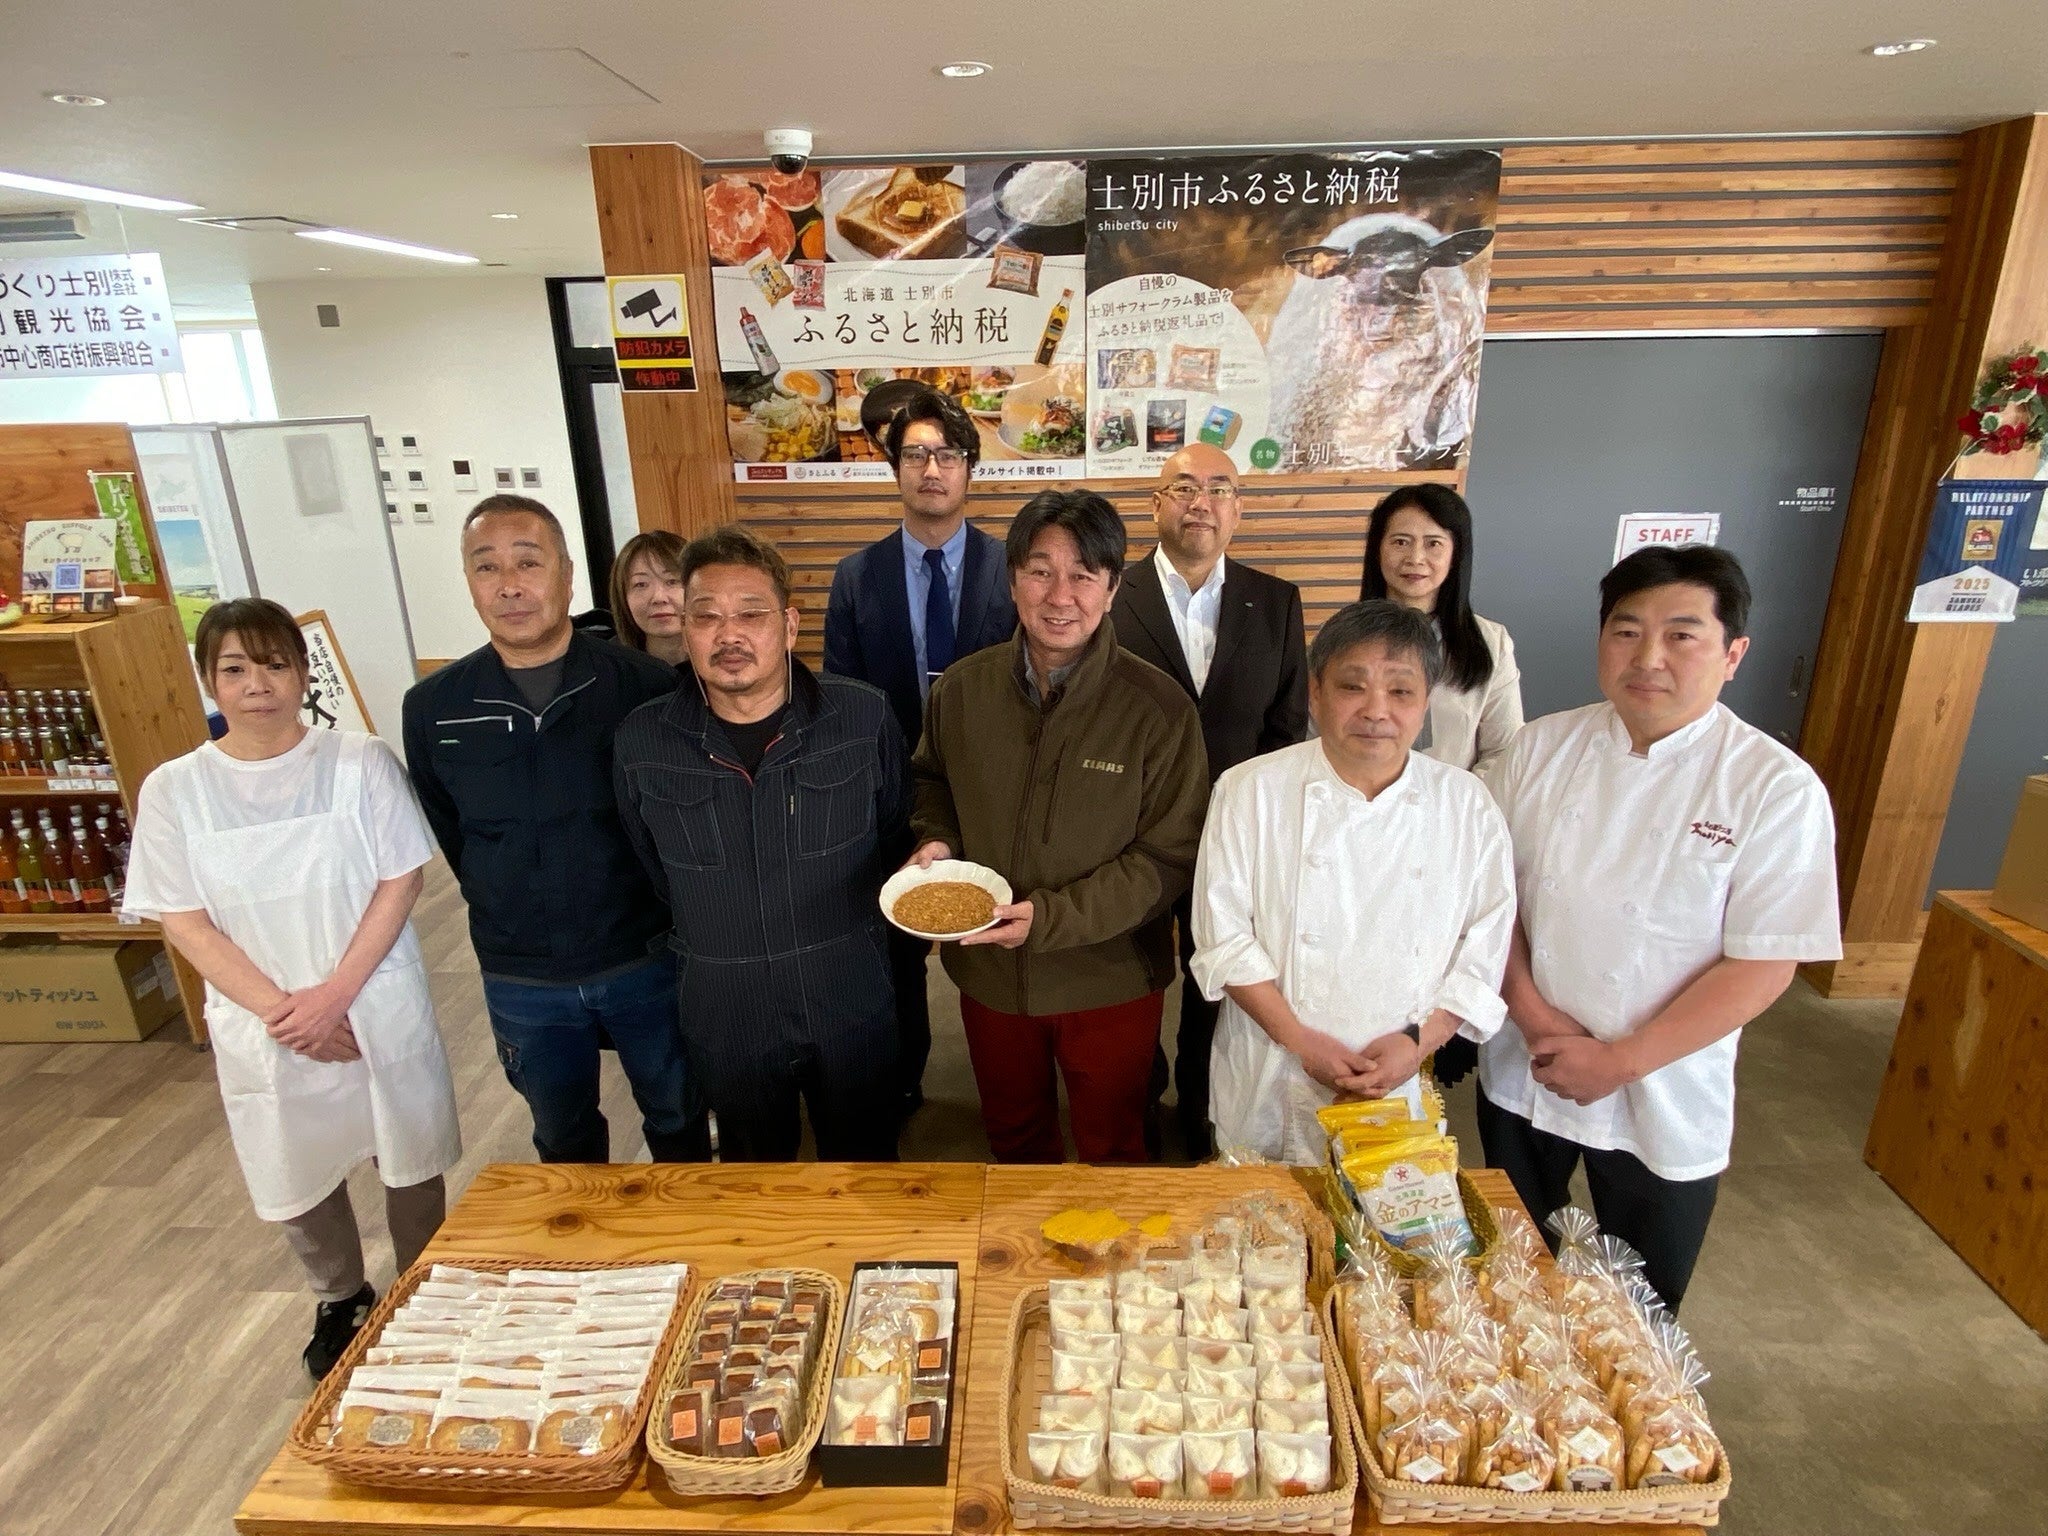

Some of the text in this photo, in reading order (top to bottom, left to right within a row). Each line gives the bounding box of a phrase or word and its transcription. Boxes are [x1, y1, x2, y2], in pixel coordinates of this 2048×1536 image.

[1092, 166, 1400, 212] 士別市ふるさと納税
[1097, 218, 1179, 232] shibetsu city
[1139, 275, 1177, 291] 自慢の
[844, 285, 955, 302] 北海道 士別市
[1088, 290, 1232, 318] 士別サフォークラム製品を
[0, 305, 146, 336] 観光協会
[793, 307, 1010, 345] ふるさと納税
[0, 340, 154, 371] 中心商店街振興組合
[618, 339, 687, 356] 防犯カメラ
[635, 370, 680, 386] 作動中
[1951, 492, 2031, 502] RELATIONSHIP
[1965, 505, 2014, 516] PARTNER
[1638, 528, 1695, 542] STAFF
[1954, 578, 1991, 590] 2025
[0, 988, 99, 1003] ットティッシュ
[1375, 1193, 1456, 1225] 金のアマニ
